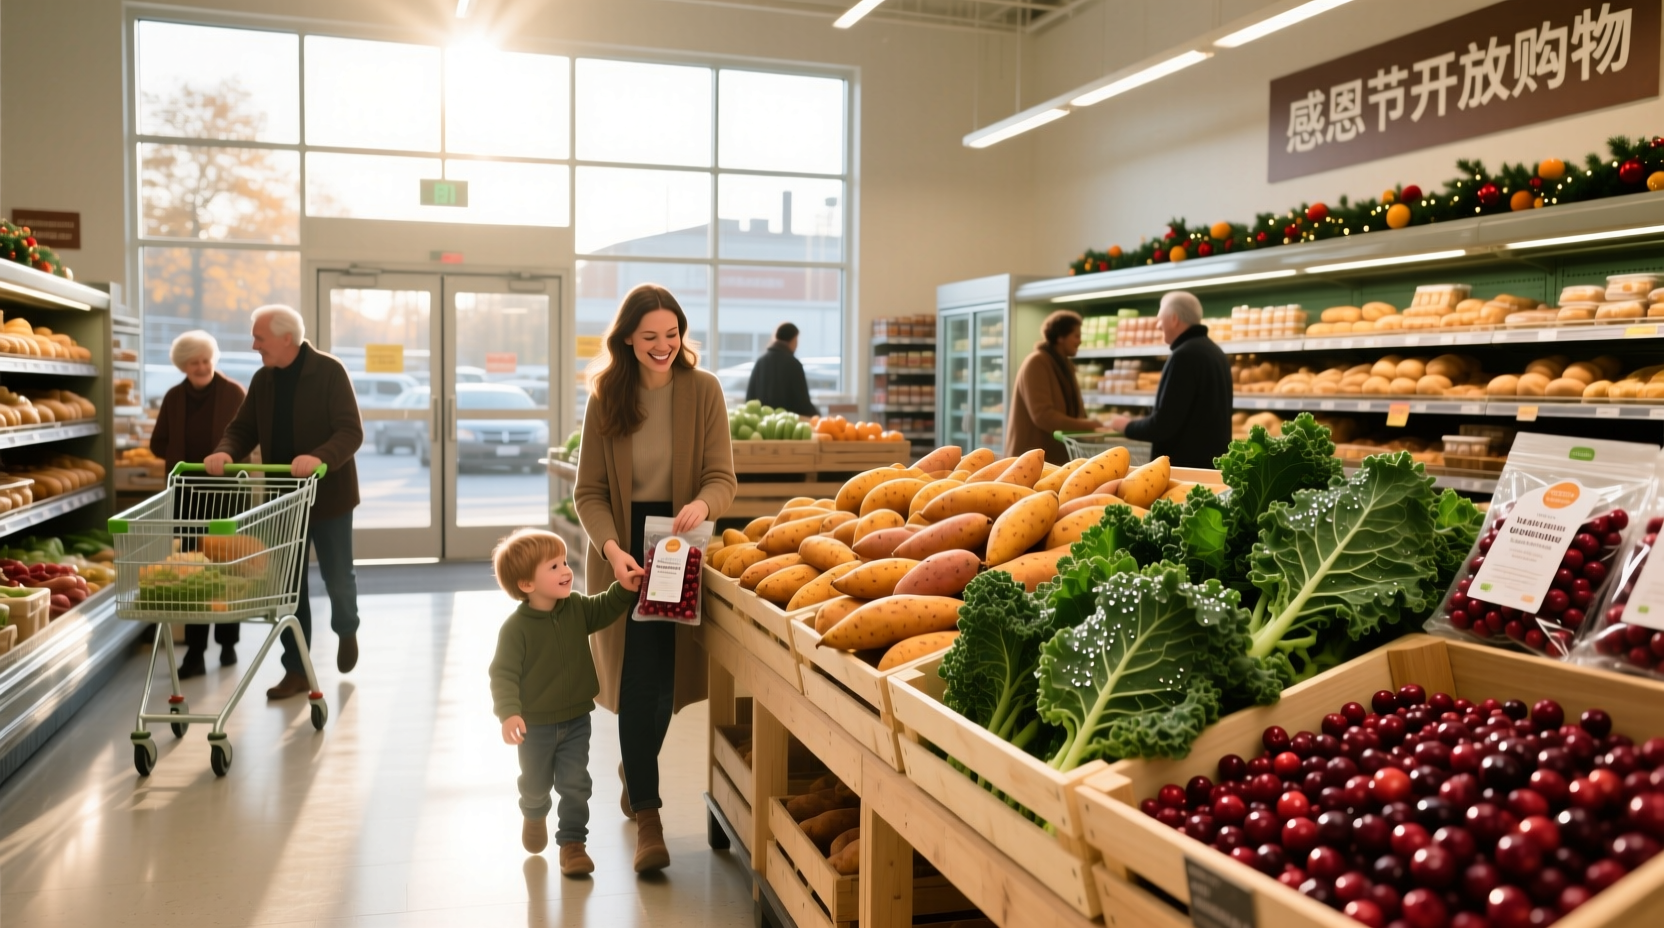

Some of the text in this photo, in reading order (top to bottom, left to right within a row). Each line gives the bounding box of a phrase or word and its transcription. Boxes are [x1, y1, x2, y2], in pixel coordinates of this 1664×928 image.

[1286, 3, 1633, 153] 感恩节开放购物
